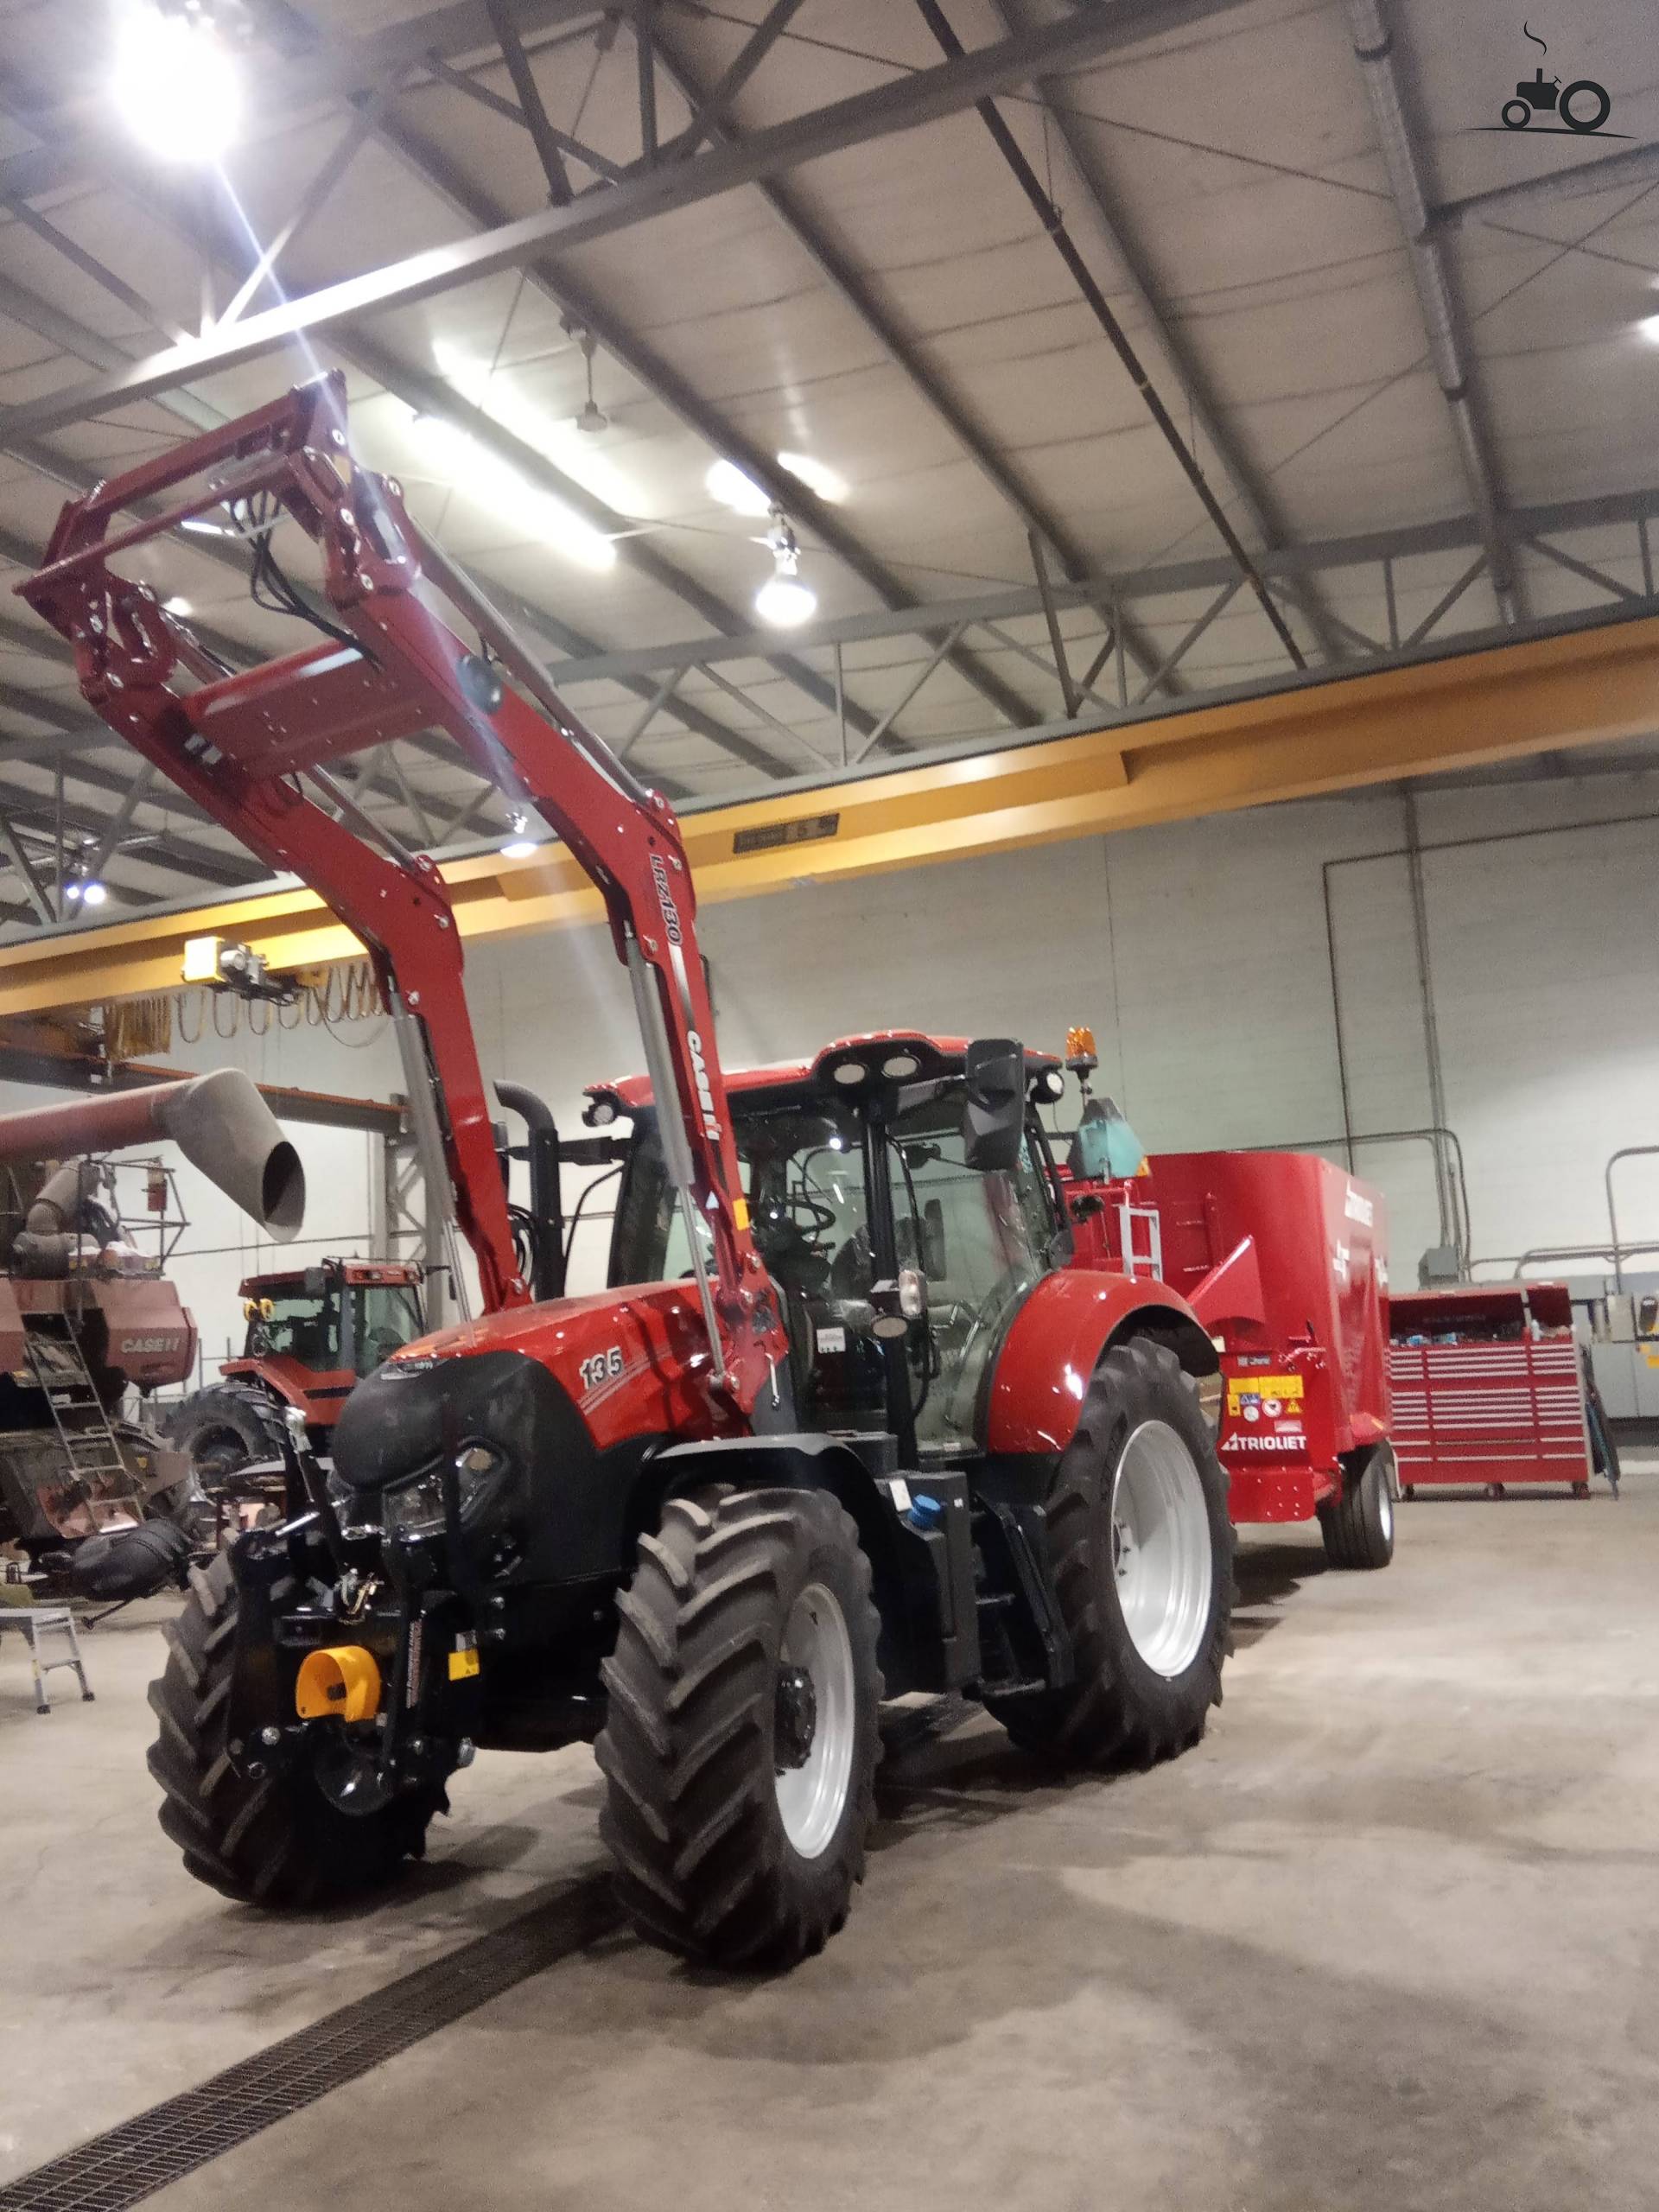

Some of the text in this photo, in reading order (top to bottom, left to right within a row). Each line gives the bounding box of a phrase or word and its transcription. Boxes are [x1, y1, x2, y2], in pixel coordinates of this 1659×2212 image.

[649, 852, 683, 946] LRZ130
[687, 1030, 715, 1111] CASE
[579, 1345, 624, 1391] 135
[1237, 1435, 1307, 1451] TRIOLIET
